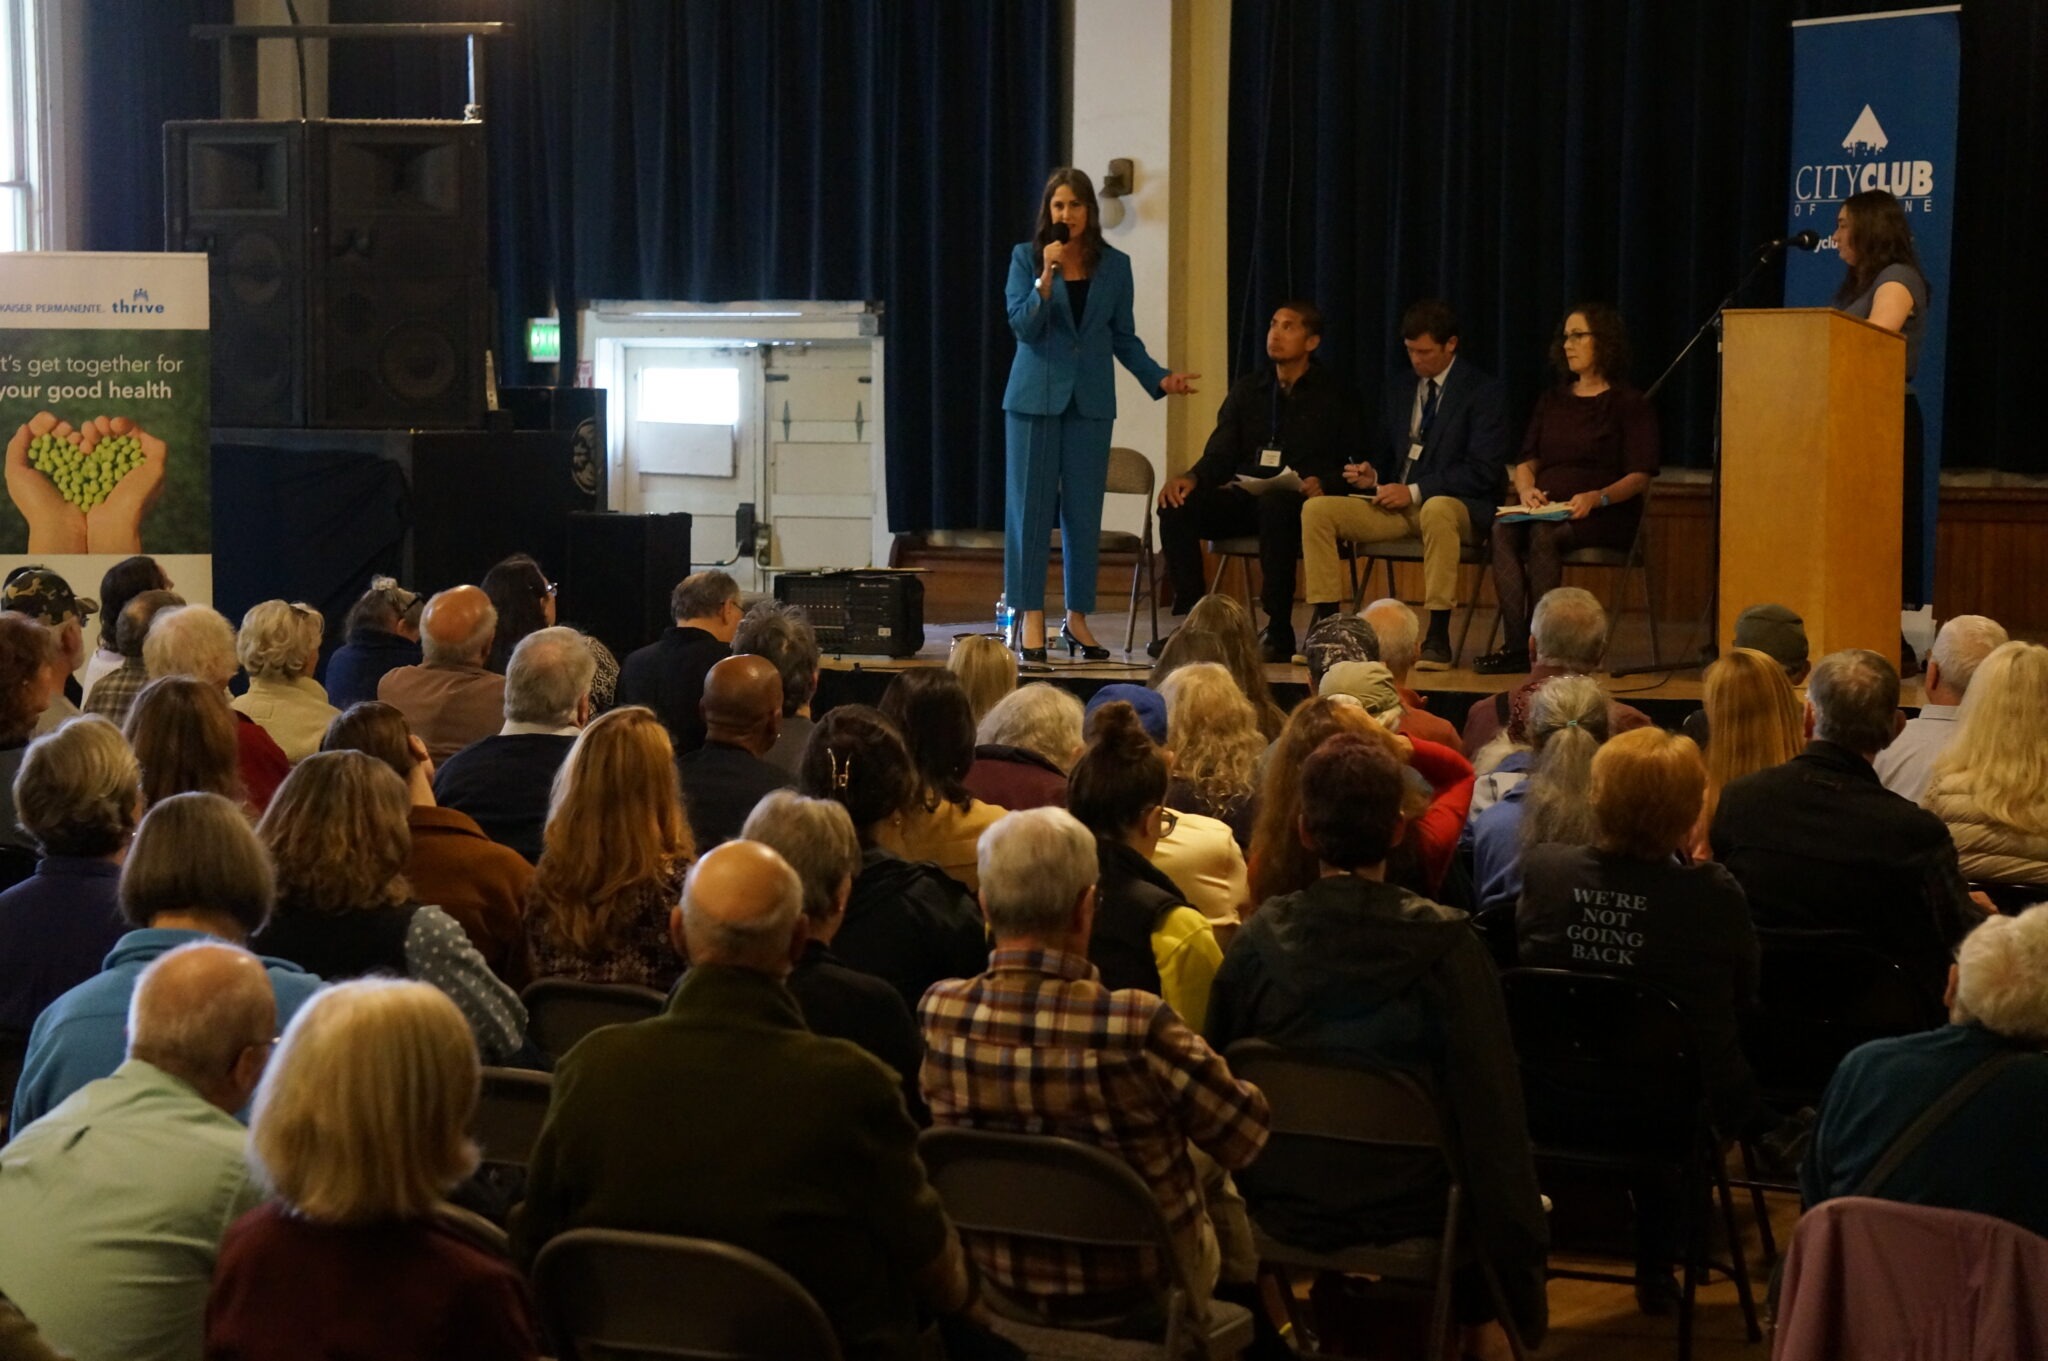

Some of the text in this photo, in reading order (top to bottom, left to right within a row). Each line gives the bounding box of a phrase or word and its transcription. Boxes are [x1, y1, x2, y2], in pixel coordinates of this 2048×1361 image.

[1794, 203, 1816, 217] OF
[112, 299, 165, 314] thrive
[28, 357, 61, 378] get
[66, 353, 151, 378] together
[156, 353, 184, 374] for
[47, 380, 102, 404] good
[109, 380, 172, 400] health
[1573, 887, 1648, 911] WE'RE
[1582, 907, 1633, 928] NOT
[1566, 924, 1644, 947] GOING
[1571, 943, 1635, 966] BACK
